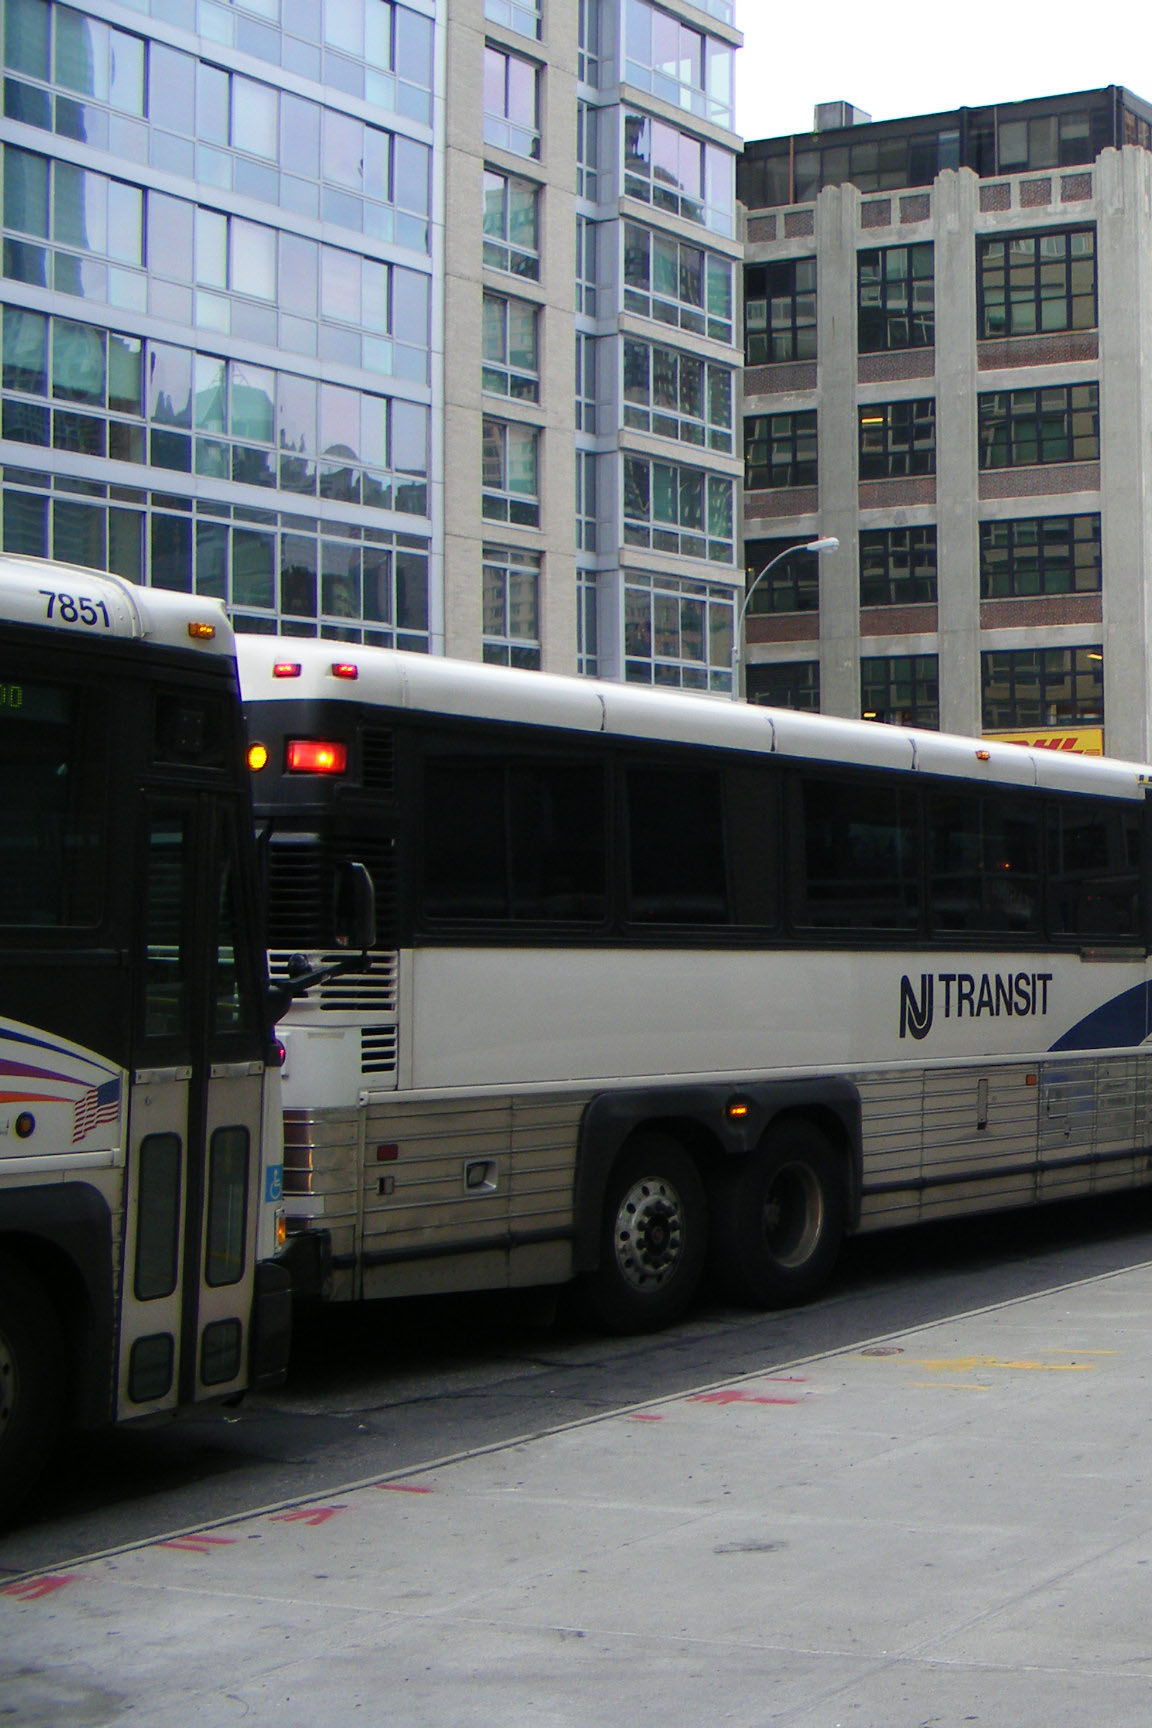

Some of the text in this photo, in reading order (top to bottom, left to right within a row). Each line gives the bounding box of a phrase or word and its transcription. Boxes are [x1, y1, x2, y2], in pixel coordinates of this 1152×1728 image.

[38, 590, 110, 628] 7851
[1003, 738, 1084, 755] HL
[938, 972, 1053, 1018] TRANSIT
